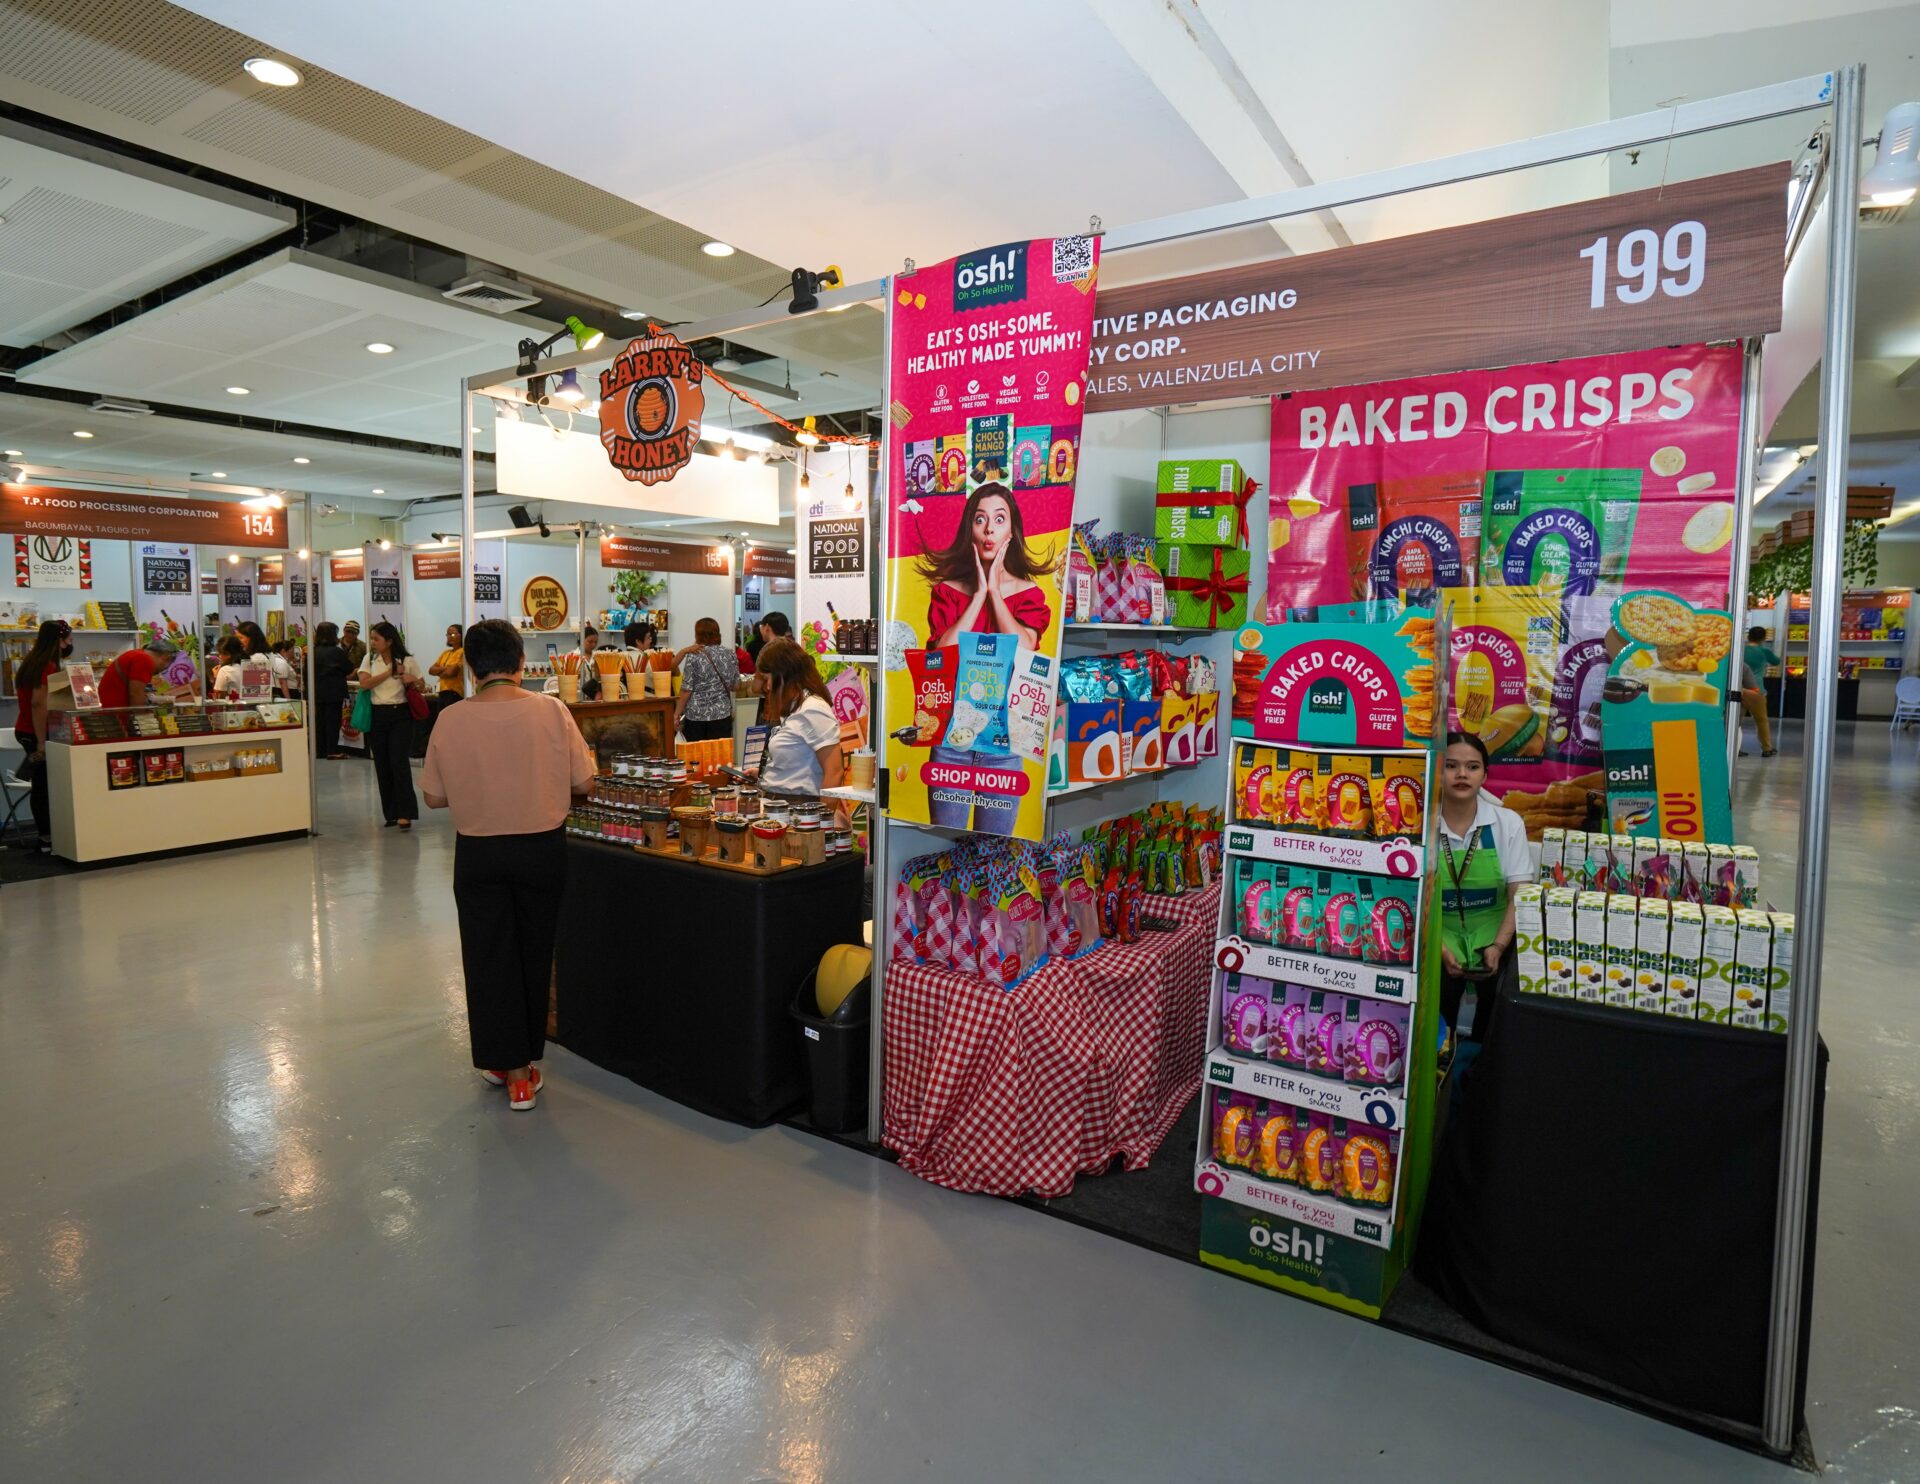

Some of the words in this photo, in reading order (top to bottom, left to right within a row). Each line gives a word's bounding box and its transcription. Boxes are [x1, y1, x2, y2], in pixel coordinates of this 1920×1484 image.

[1580, 221, 1707, 309] 199
[1057, 274, 1076, 283] SCAN
[958, 290, 968, 300] Oh
[971, 288, 980, 297] So
[982, 284, 1014, 297] Healthy
[1144, 289, 1297, 331] PACKAGING
[927, 328, 964, 349] EAT'S
[968, 312, 1058, 341] OSH-SOME,
[907, 349, 967, 374] HEALTHY
[972, 341, 1015, 364] MADE
[1020, 331, 1081, 356] YUMMY!
[1115, 336, 1186, 362] CORP.
[600, 348, 702, 400] LARRY'S
[1086, 375, 1131, 394] ALES,
[1138, 359, 1262, 388] VALENZUELA
[1271, 351, 1321, 373] CITY
[959, 393, 989, 402] CHOLESTEROL
[996, 396, 1021, 404] FRIENDLY
[1000, 388, 1018, 396] VEGAN
[1300, 391, 1468, 449] BAKED
[1484, 368, 1695, 434] CRISPS
[975, 431, 1004, 442] CHOCO
[614, 429, 689, 469] HONEY
[975, 441, 1004, 451] MANGO
[1174, 466, 1189, 492] FRUI
[23, 496, 43, 506] T.P.
[46, 499, 77, 509] FOOD
[80, 501, 146, 513] PROCESSING
[148, 507, 218, 519] CORPORATION
[810, 501, 823, 514] dti
[26, 521, 92, 532] BAGUMBAYAN,
[96, 526, 129, 535] TAGUIG
[131, 528, 150, 536] CITY
[242, 514, 274, 536] 154
[814, 522, 859, 534] NATIONAL
[1171, 507, 1187, 538] RISPS
[1380, 522, 1412, 557] KIMCHI
[1415, 522, 1451, 552] CRISPS
[1516, 515, 1554, 548] BAKED
[1558, 514, 1592, 549] CRISPS
[143, 545, 155, 554] dti
[629, 546, 660, 554] CHOCOLATES,
[814, 539, 859, 555] FOOD
[706, 553, 721, 567] 155
[147, 570, 187, 580] FOOD
[1080, 580, 1088, 589] SALE
[531, 588, 560, 599] DULCHE
[1886, 596, 1903, 604] 227
[1478, 632, 1516, 667] CRISPS
[1564, 644, 1606, 679] BAKED
[968, 668, 998, 684] Osh
[1271, 652, 1324, 699] BAKED
[1331, 651, 1388, 701] CRISPS
[922, 679, 945, 694] Osh
[1019, 683, 1046, 703] Osh
[1264, 708, 1286, 716] NEVER
[1265, 716, 1284, 724] FRIED
[1369, 714, 1397, 723] GLUTEN
[1373, 722, 1392, 730] FREE
[931, 768, 971, 783] SHOP
[976, 773, 1017, 790] NOW!
[1332, 775, 1349, 788] BAKED
[1351, 775, 1368, 790] CRISPS
[1388, 778, 1402, 792] BAKED
[1404, 778, 1421, 793] CRISPS
[933, 791, 1011, 809] ohsohealthy.com
[1274, 837, 1315, 851] BETTER
[1320, 841, 1336, 853] for
[1340, 848, 1363, 858] you
[1330, 856, 1361, 865] SNACKS
[1268, 956, 1309, 971] BETTER
[1313, 964, 1330, 975] for
[1334, 969, 1357, 981] you
[1324, 978, 1355, 989] SNACKS
[1254, 1072, 1295, 1091] BETTER
[1299, 1083, 1315, 1096] for
[1319, 1092, 1341, 1103] you
[1309, 1097, 1340, 1111] SNACKS
[1247, 1186, 1288, 1206] BETTER
[1292, 1200, 1309, 1211] for
[1313, 1208, 1335, 1221] you
[1302, 1213, 1335, 1228] SNACKS
[1249, 1246, 1264, 1257] Oh
[1266, 1251, 1278, 1262] So
[1282, 1254, 1323, 1277] Healthy
